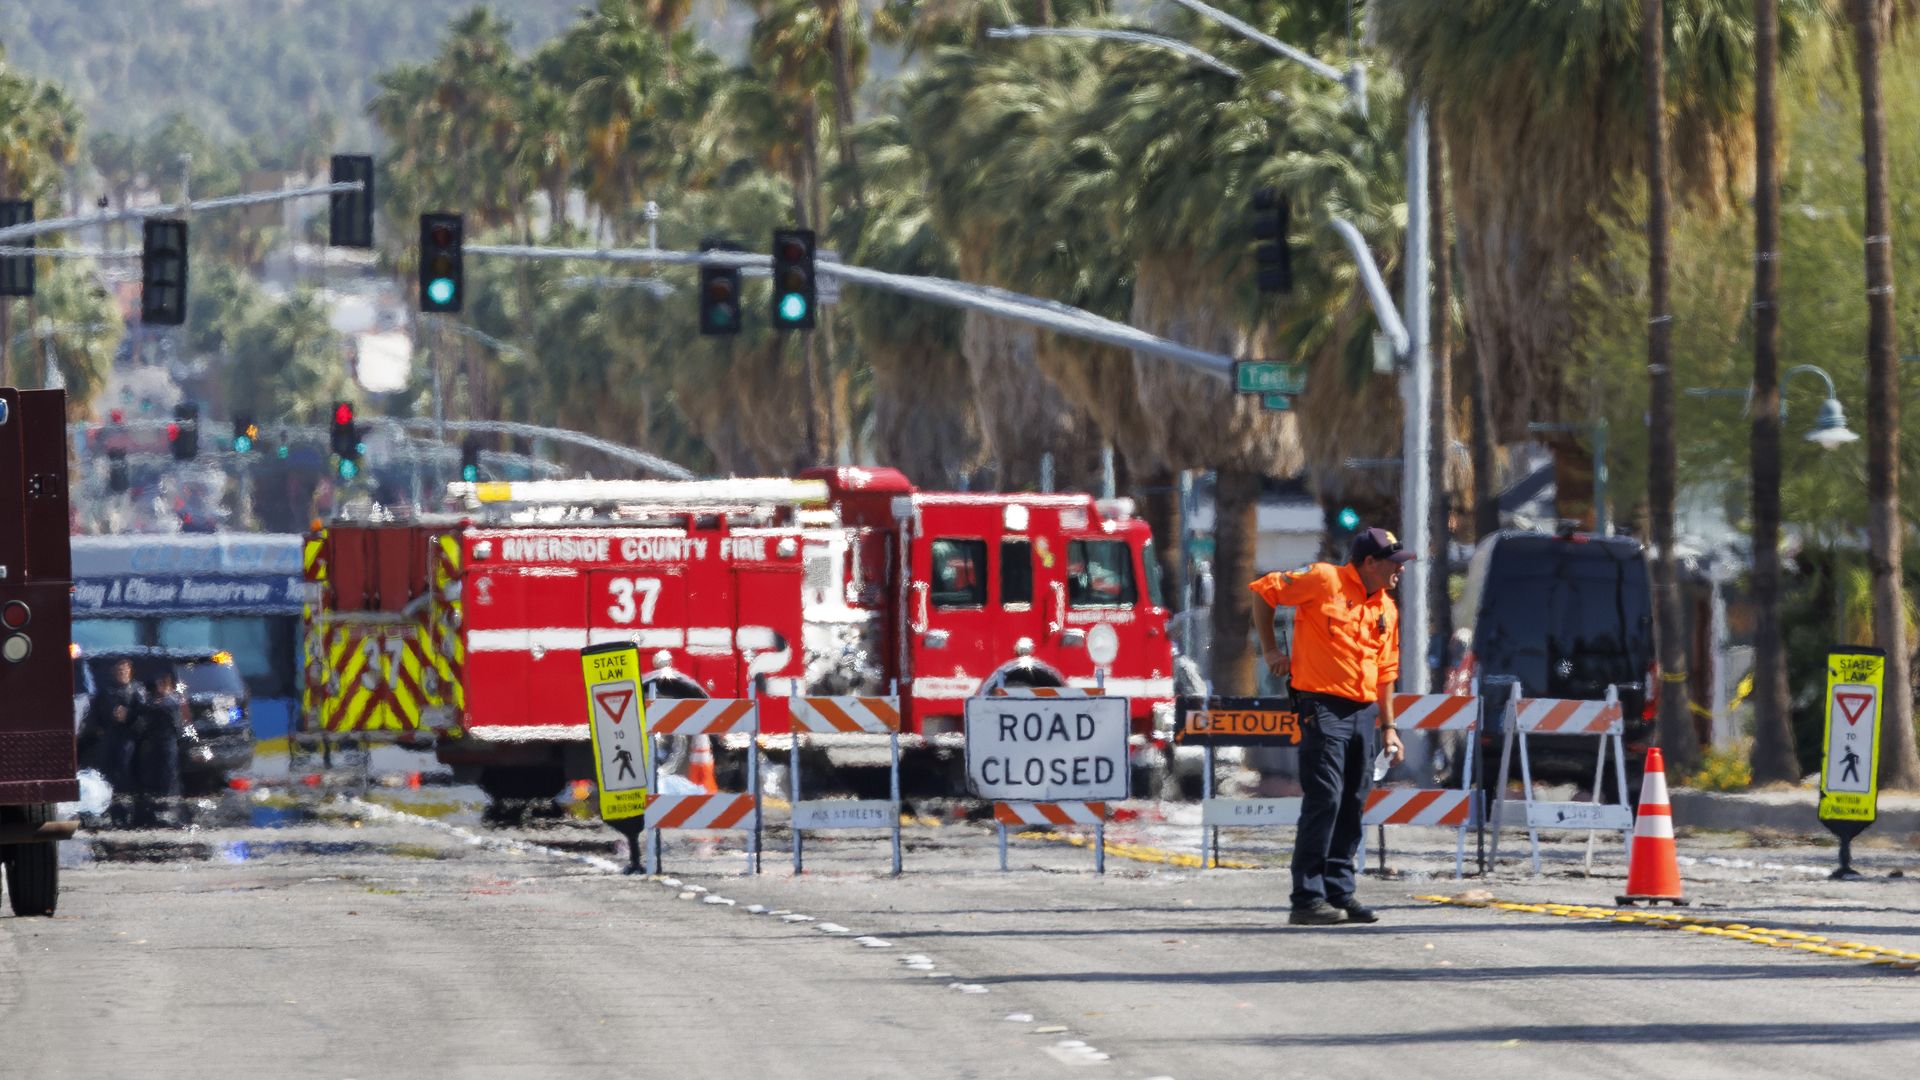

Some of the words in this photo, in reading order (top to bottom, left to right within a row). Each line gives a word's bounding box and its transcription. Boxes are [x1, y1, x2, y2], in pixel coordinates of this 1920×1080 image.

[502, 538, 610, 561] RIVERSIDE
[620, 538, 708, 561] COUNTY
[719, 538, 766, 561] FIRE
[607, 577, 662, 625] 37
[361, 637, 404, 690] 37
[593, 655, 628, 669] STATE
[1840, 659, 1873, 670] STATE
[600, 669, 624, 681] LAW
[1843, 671, 1869, 682] LAW
[999, 712, 1096, 742] ROAD
[1192, 713, 1296, 732] DETOUR
[1846, 732, 1857, 741] TO
[981, 756, 1115, 786] CLOSED
